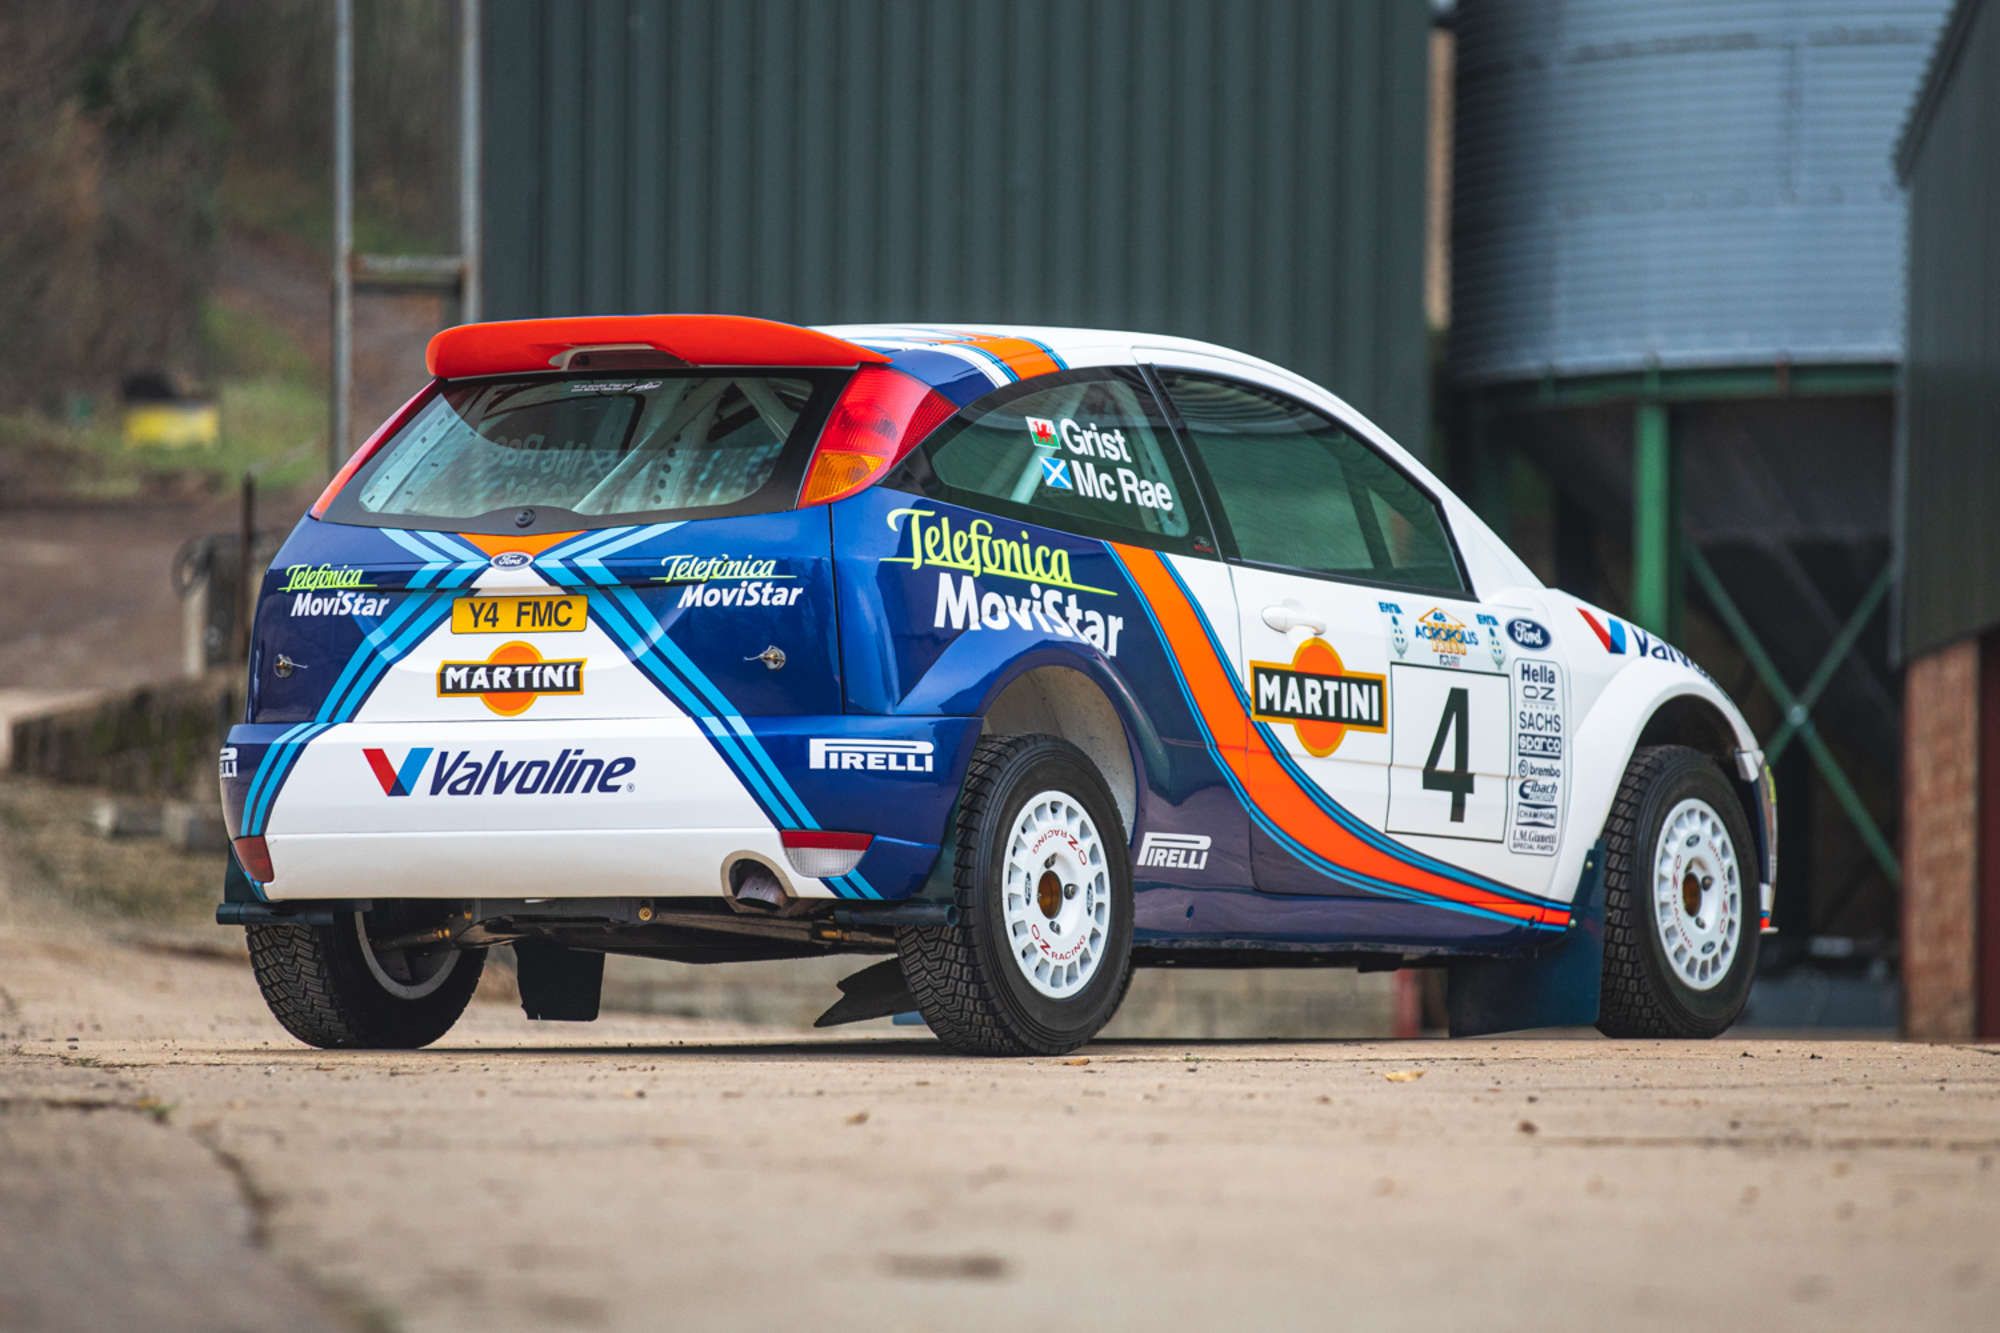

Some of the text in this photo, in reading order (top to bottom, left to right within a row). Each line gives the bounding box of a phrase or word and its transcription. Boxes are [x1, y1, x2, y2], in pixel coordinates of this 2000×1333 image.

[1060, 418, 1132, 463] Grist
[1070, 460, 1174, 511] Mc Rae
[498, 555, 523, 566] Ford
[290, 590, 390, 617] MoviStar
[677, 580, 804, 609] MoviStar
[469, 600, 574, 628] Y4 FMC
[934, 572, 1124, 658] MoviStar
[1415, 625, 1479, 646] ACROPOLIS
[1514, 620, 1544, 646] Ford
[445, 664, 577, 690] MARTINI
[1521, 663, 1556, 684] Hella
[1258, 673, 1380, 722] MARTINI
[1523, 685, 1556, 701] OZ
[1519, 711, 1561, 733] SACHS
[809, 738, 934, 772] PIRELLI
[1422, 687, 1475, 823] 4
[1519, 736, 1560, 753] sparco
[429, 748, 637, 796] Valvoline
[1530, 762, 1561, 778] brembo
[1032, 829, 1088, 866] OZ RACING
[1136, 832, 1212, 870] PIRELLI
[1031, 924, 1087, 960] OZ RACING
